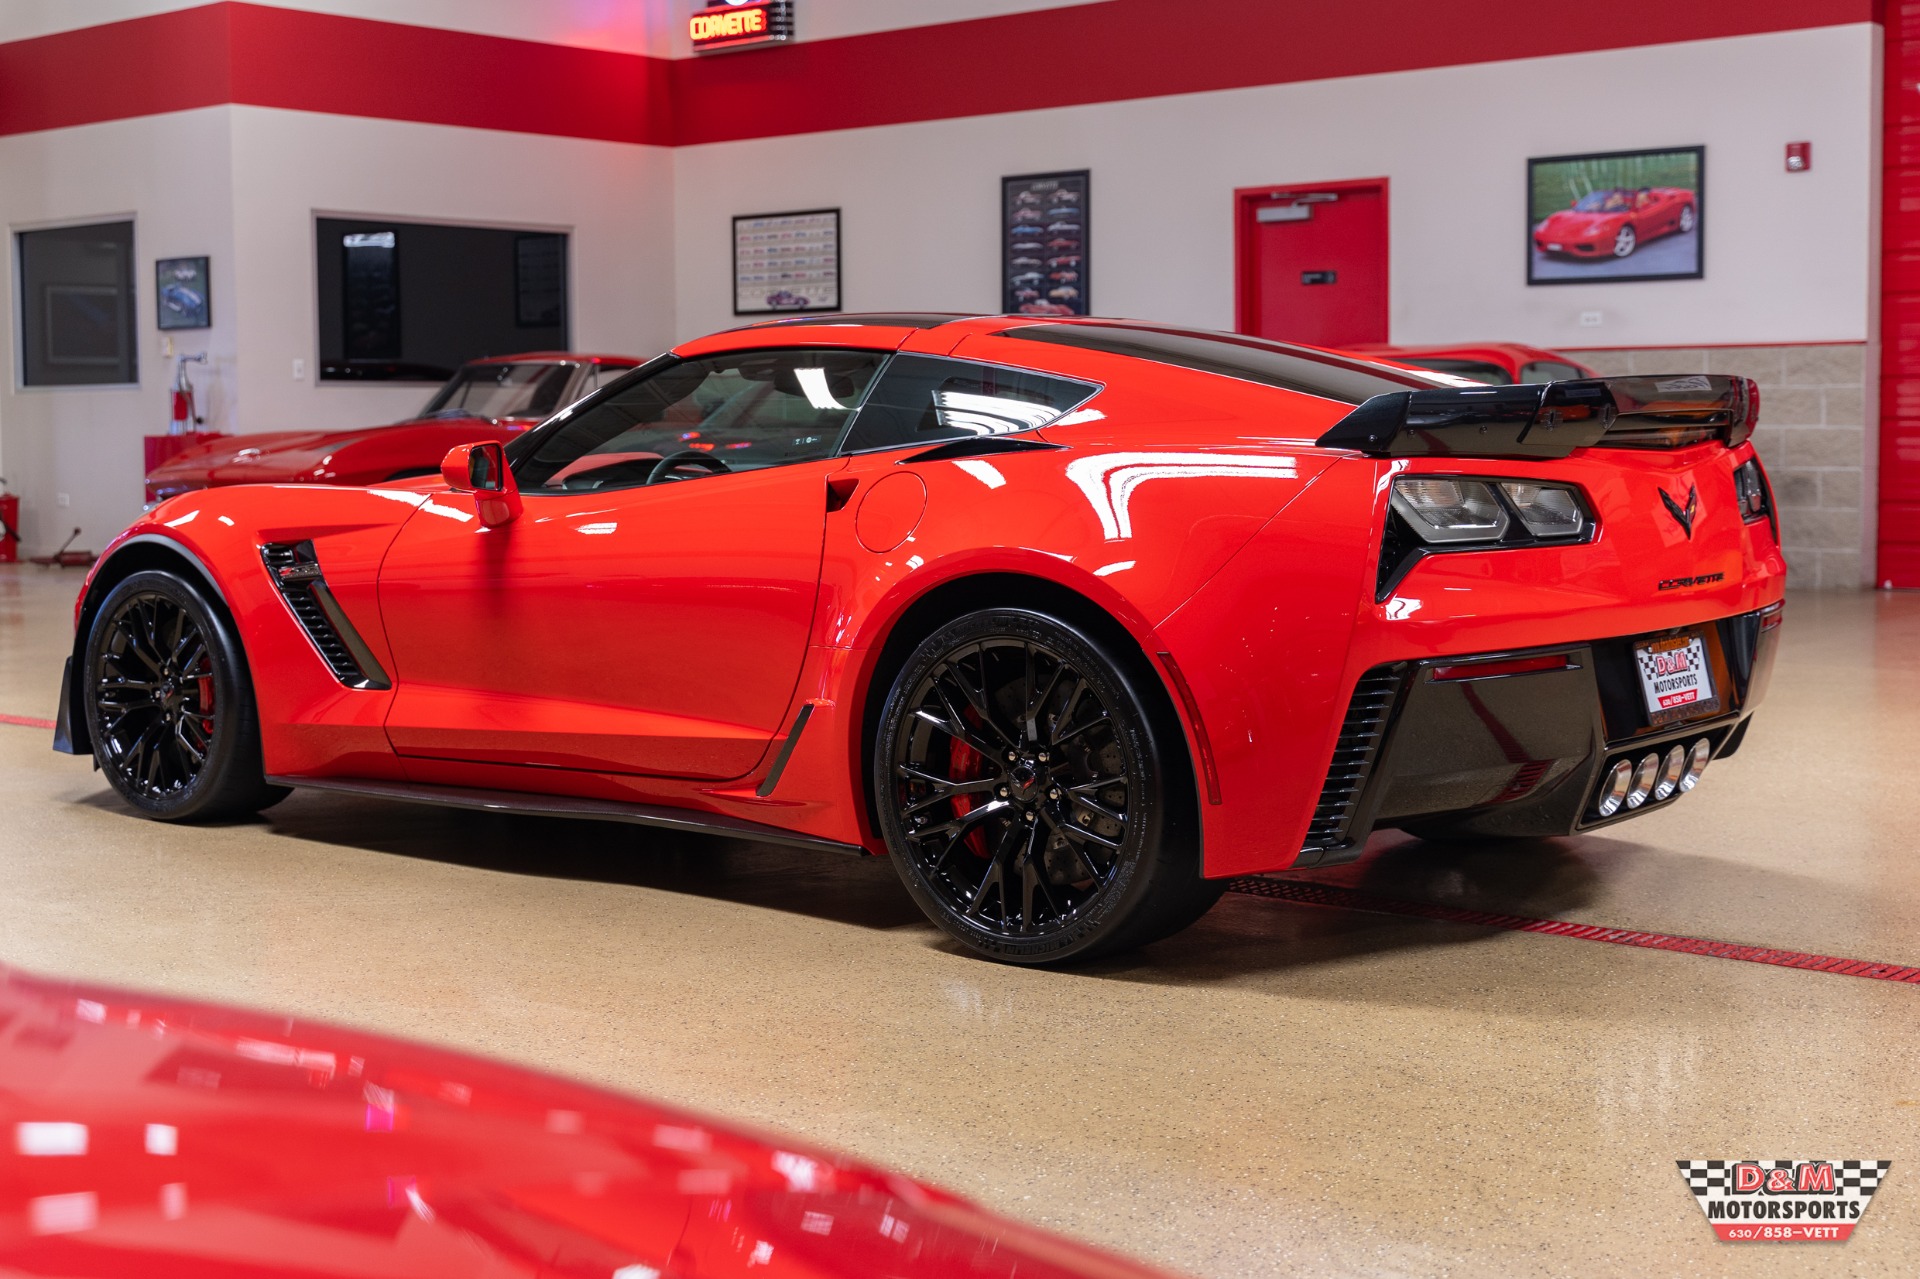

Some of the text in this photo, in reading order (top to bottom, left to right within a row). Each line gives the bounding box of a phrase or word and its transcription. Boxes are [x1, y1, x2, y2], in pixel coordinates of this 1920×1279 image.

[689, 8, 767, 40] CORVETTE
[1658, 571, 1724, 590] CORVETTE
[1656, 651, 1688, 676] D&M
[1653, 673, 1698, 694] MOTORSPORTS
